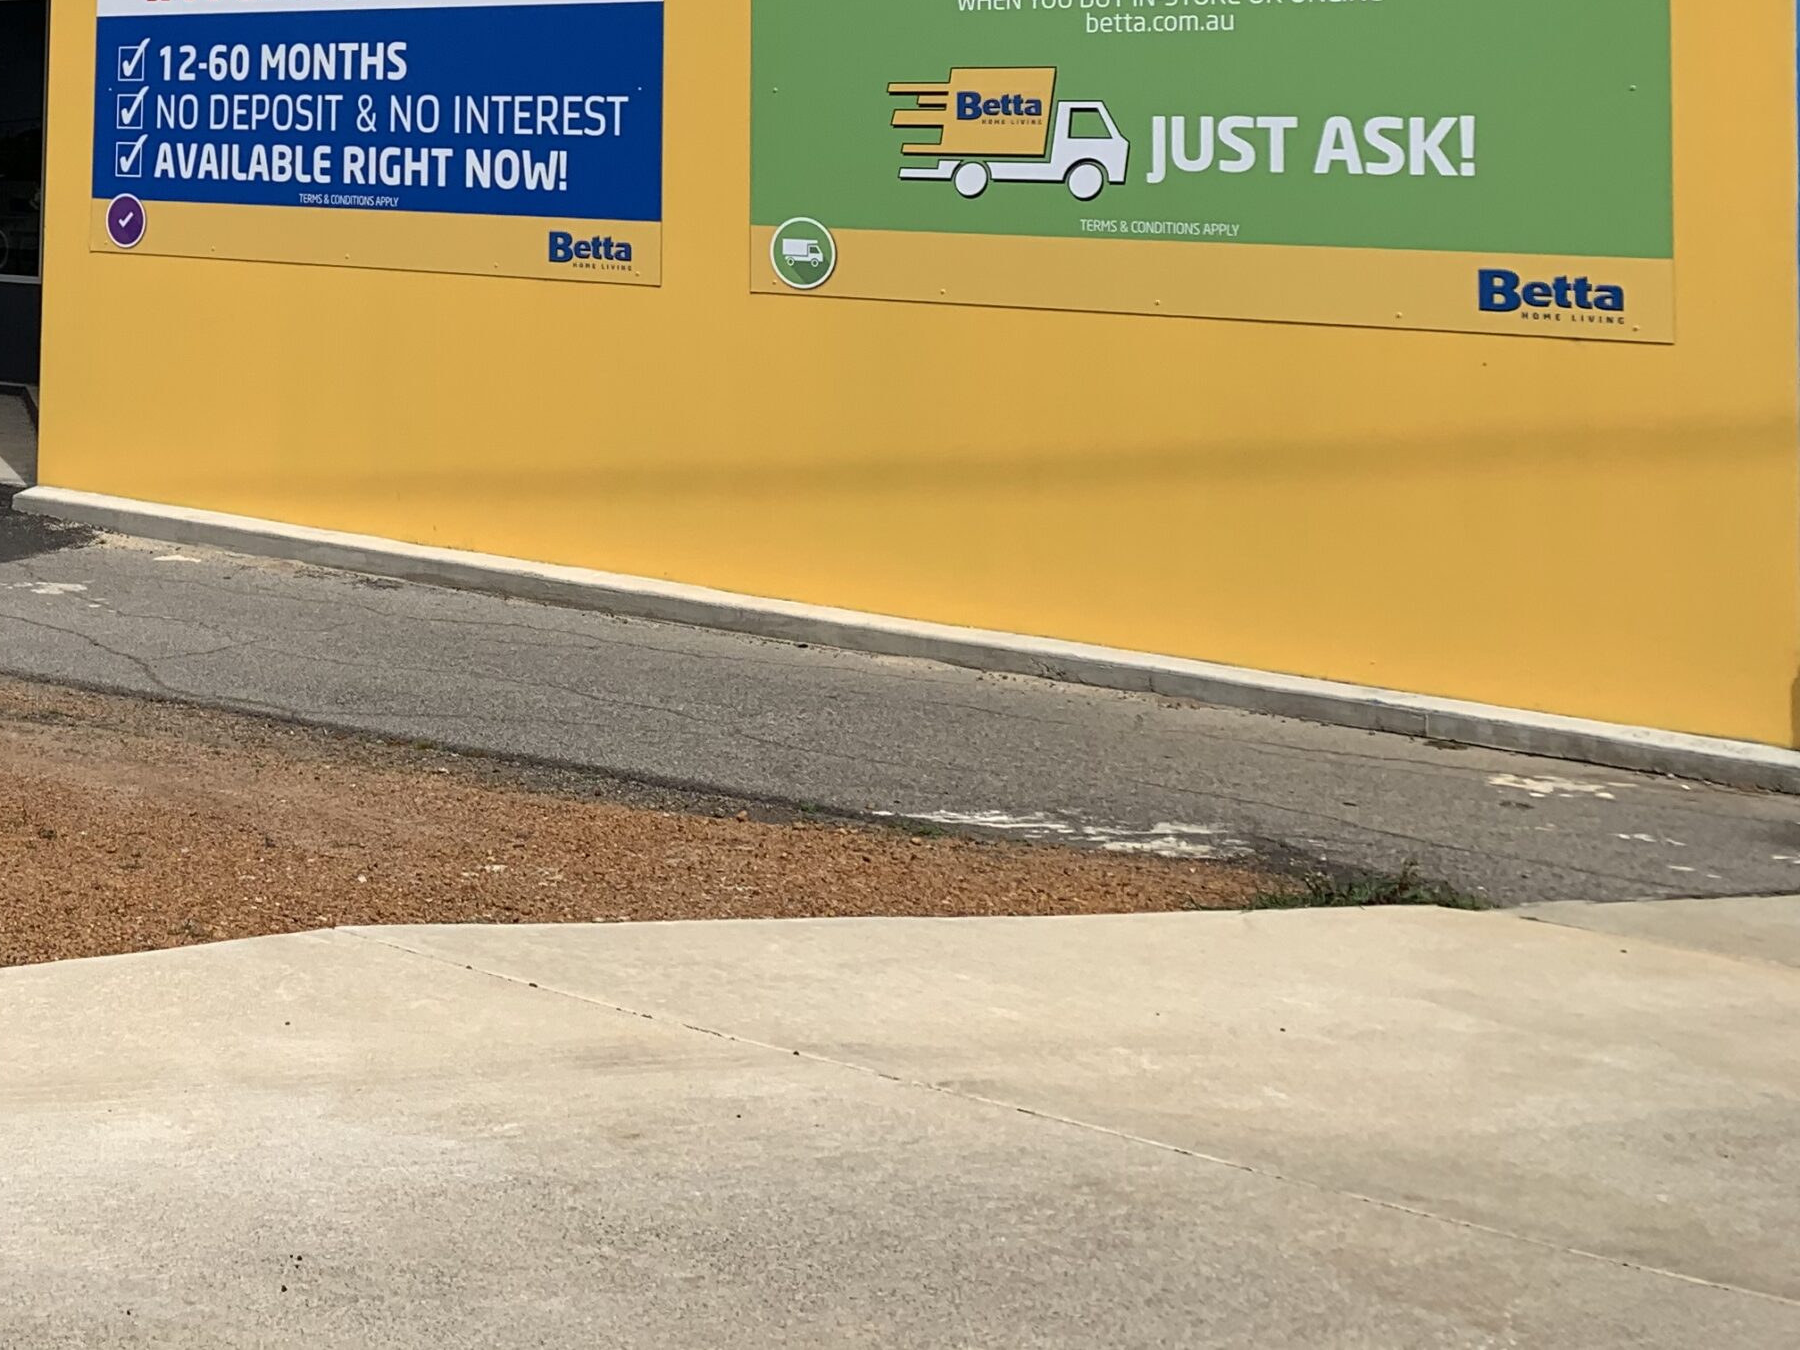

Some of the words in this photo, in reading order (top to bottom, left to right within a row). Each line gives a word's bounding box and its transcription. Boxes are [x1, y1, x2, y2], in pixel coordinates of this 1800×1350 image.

[1086, 13, 1235, 34] betta.com.au
[159, 44, 249, 82] 12-60
[260, 41, 407, 81] MONTHS
[155, 94, 199, 131] NO
[210, 94, 343, 132] DEPOSIT
[356, 97, 378, 133] &
[389, 96, 440, 134] NO
[454, 96, 629, 137] INTEREST
[956, 91, 1042, 121] Betta
[1147, 115, 1298, 185] JUST
[1313, 114, 1477, 177] ASK!
[153, 142, 331, 183] AVAILABLE
[342, 146, 453, 188] RIGHT
[464, 150, 568, 191] NOW!
[299, 193, 322, 204] TERMS
[323, 194, 329, 204] &
[330, 194, 374, 206] CONDITIONS
[375, 196, 399, 207] APPLY
[1080, 218, 1117, 233] TERMS
[1119, 220, 1129, 233] &
[1130, 221, 1200, 236] CONDITIONS
[1202, 223, 1240, 237] APPLY
[548, 231, 632, 263] Betta
[572, 262, 596, 270] HOME
[601, 263, 632, 272] LIVING
[1478, 268, 1625, 312] Betta
[1521, 312, 1561, 322] HOME
[1571, 314, 1625, 325] LIVING
